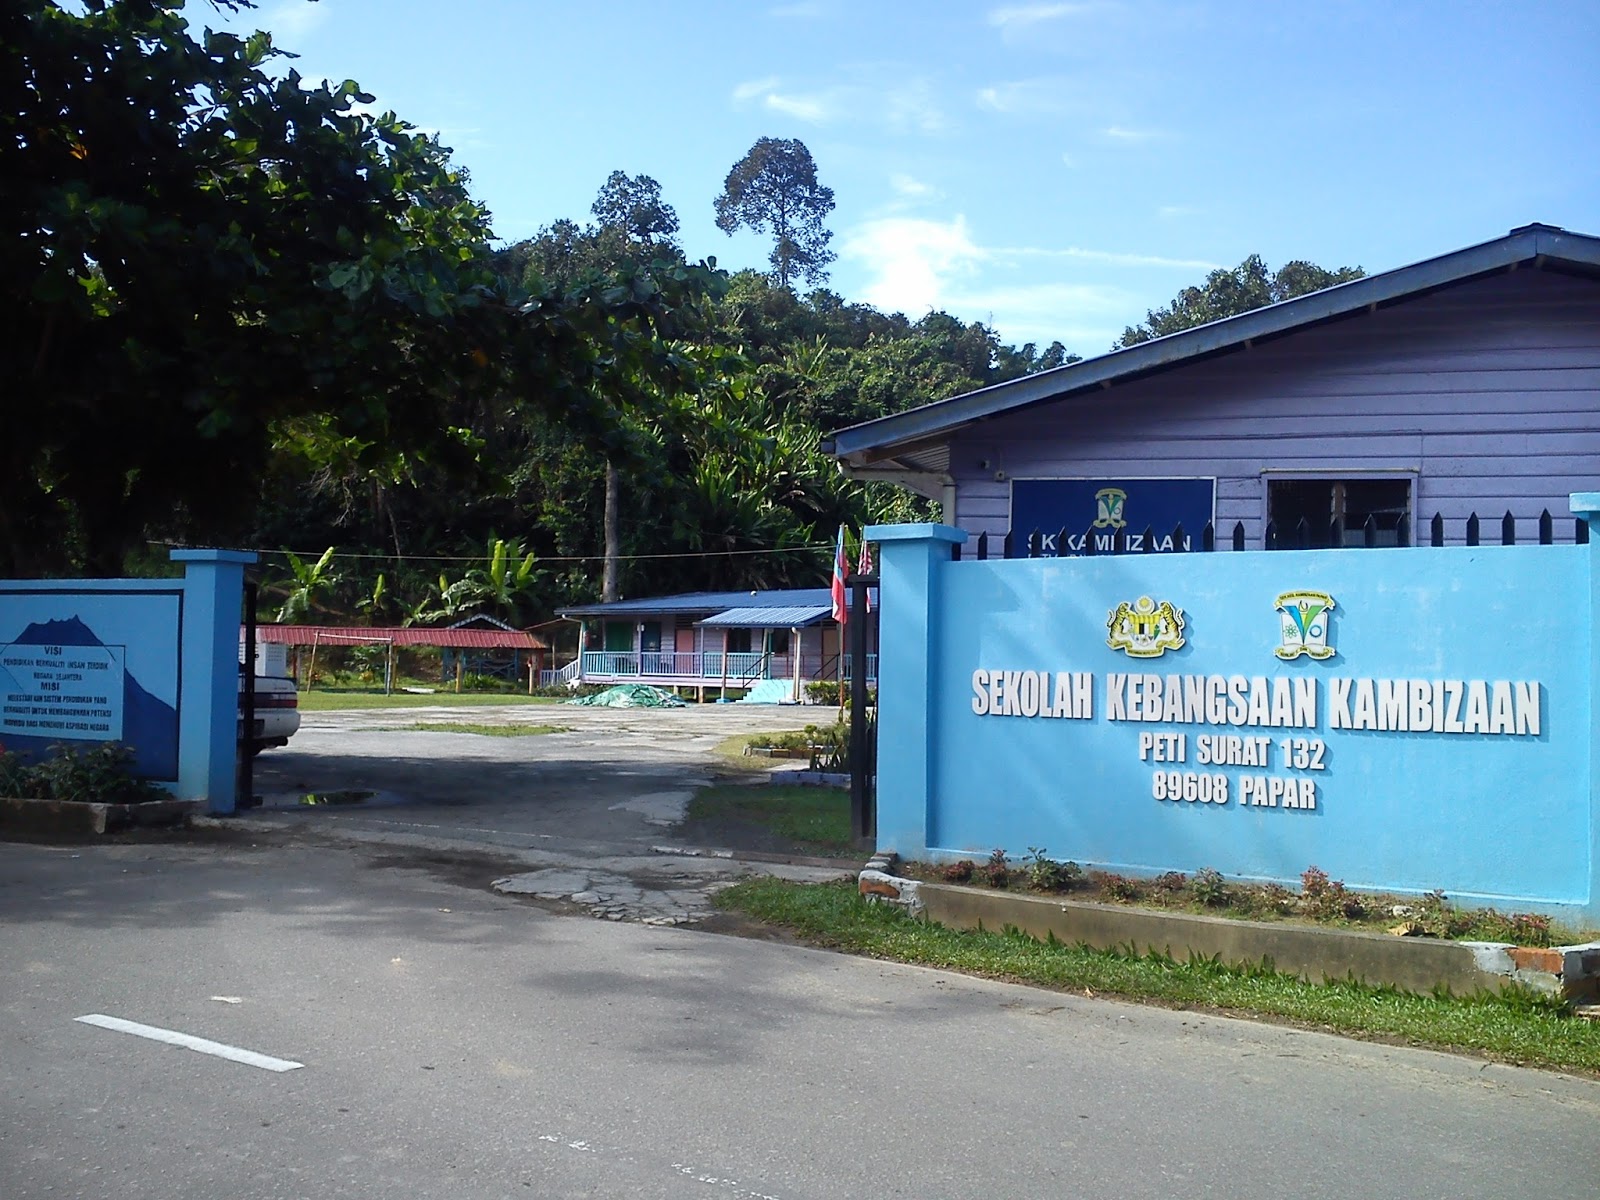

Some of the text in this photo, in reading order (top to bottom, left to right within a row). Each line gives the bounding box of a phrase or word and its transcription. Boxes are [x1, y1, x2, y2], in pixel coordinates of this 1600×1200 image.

[44, 645, 62, 656] VISI
[40, 681, 60, 691] MISI
[972, 669, 1542, 736] SEKOLAH KEBANGSAAN KAMBIZAAN
[1138, 732, 1326, 771] PETI SURAT 132
[1152, 770, 1317, 810] 89608 PAPAR
